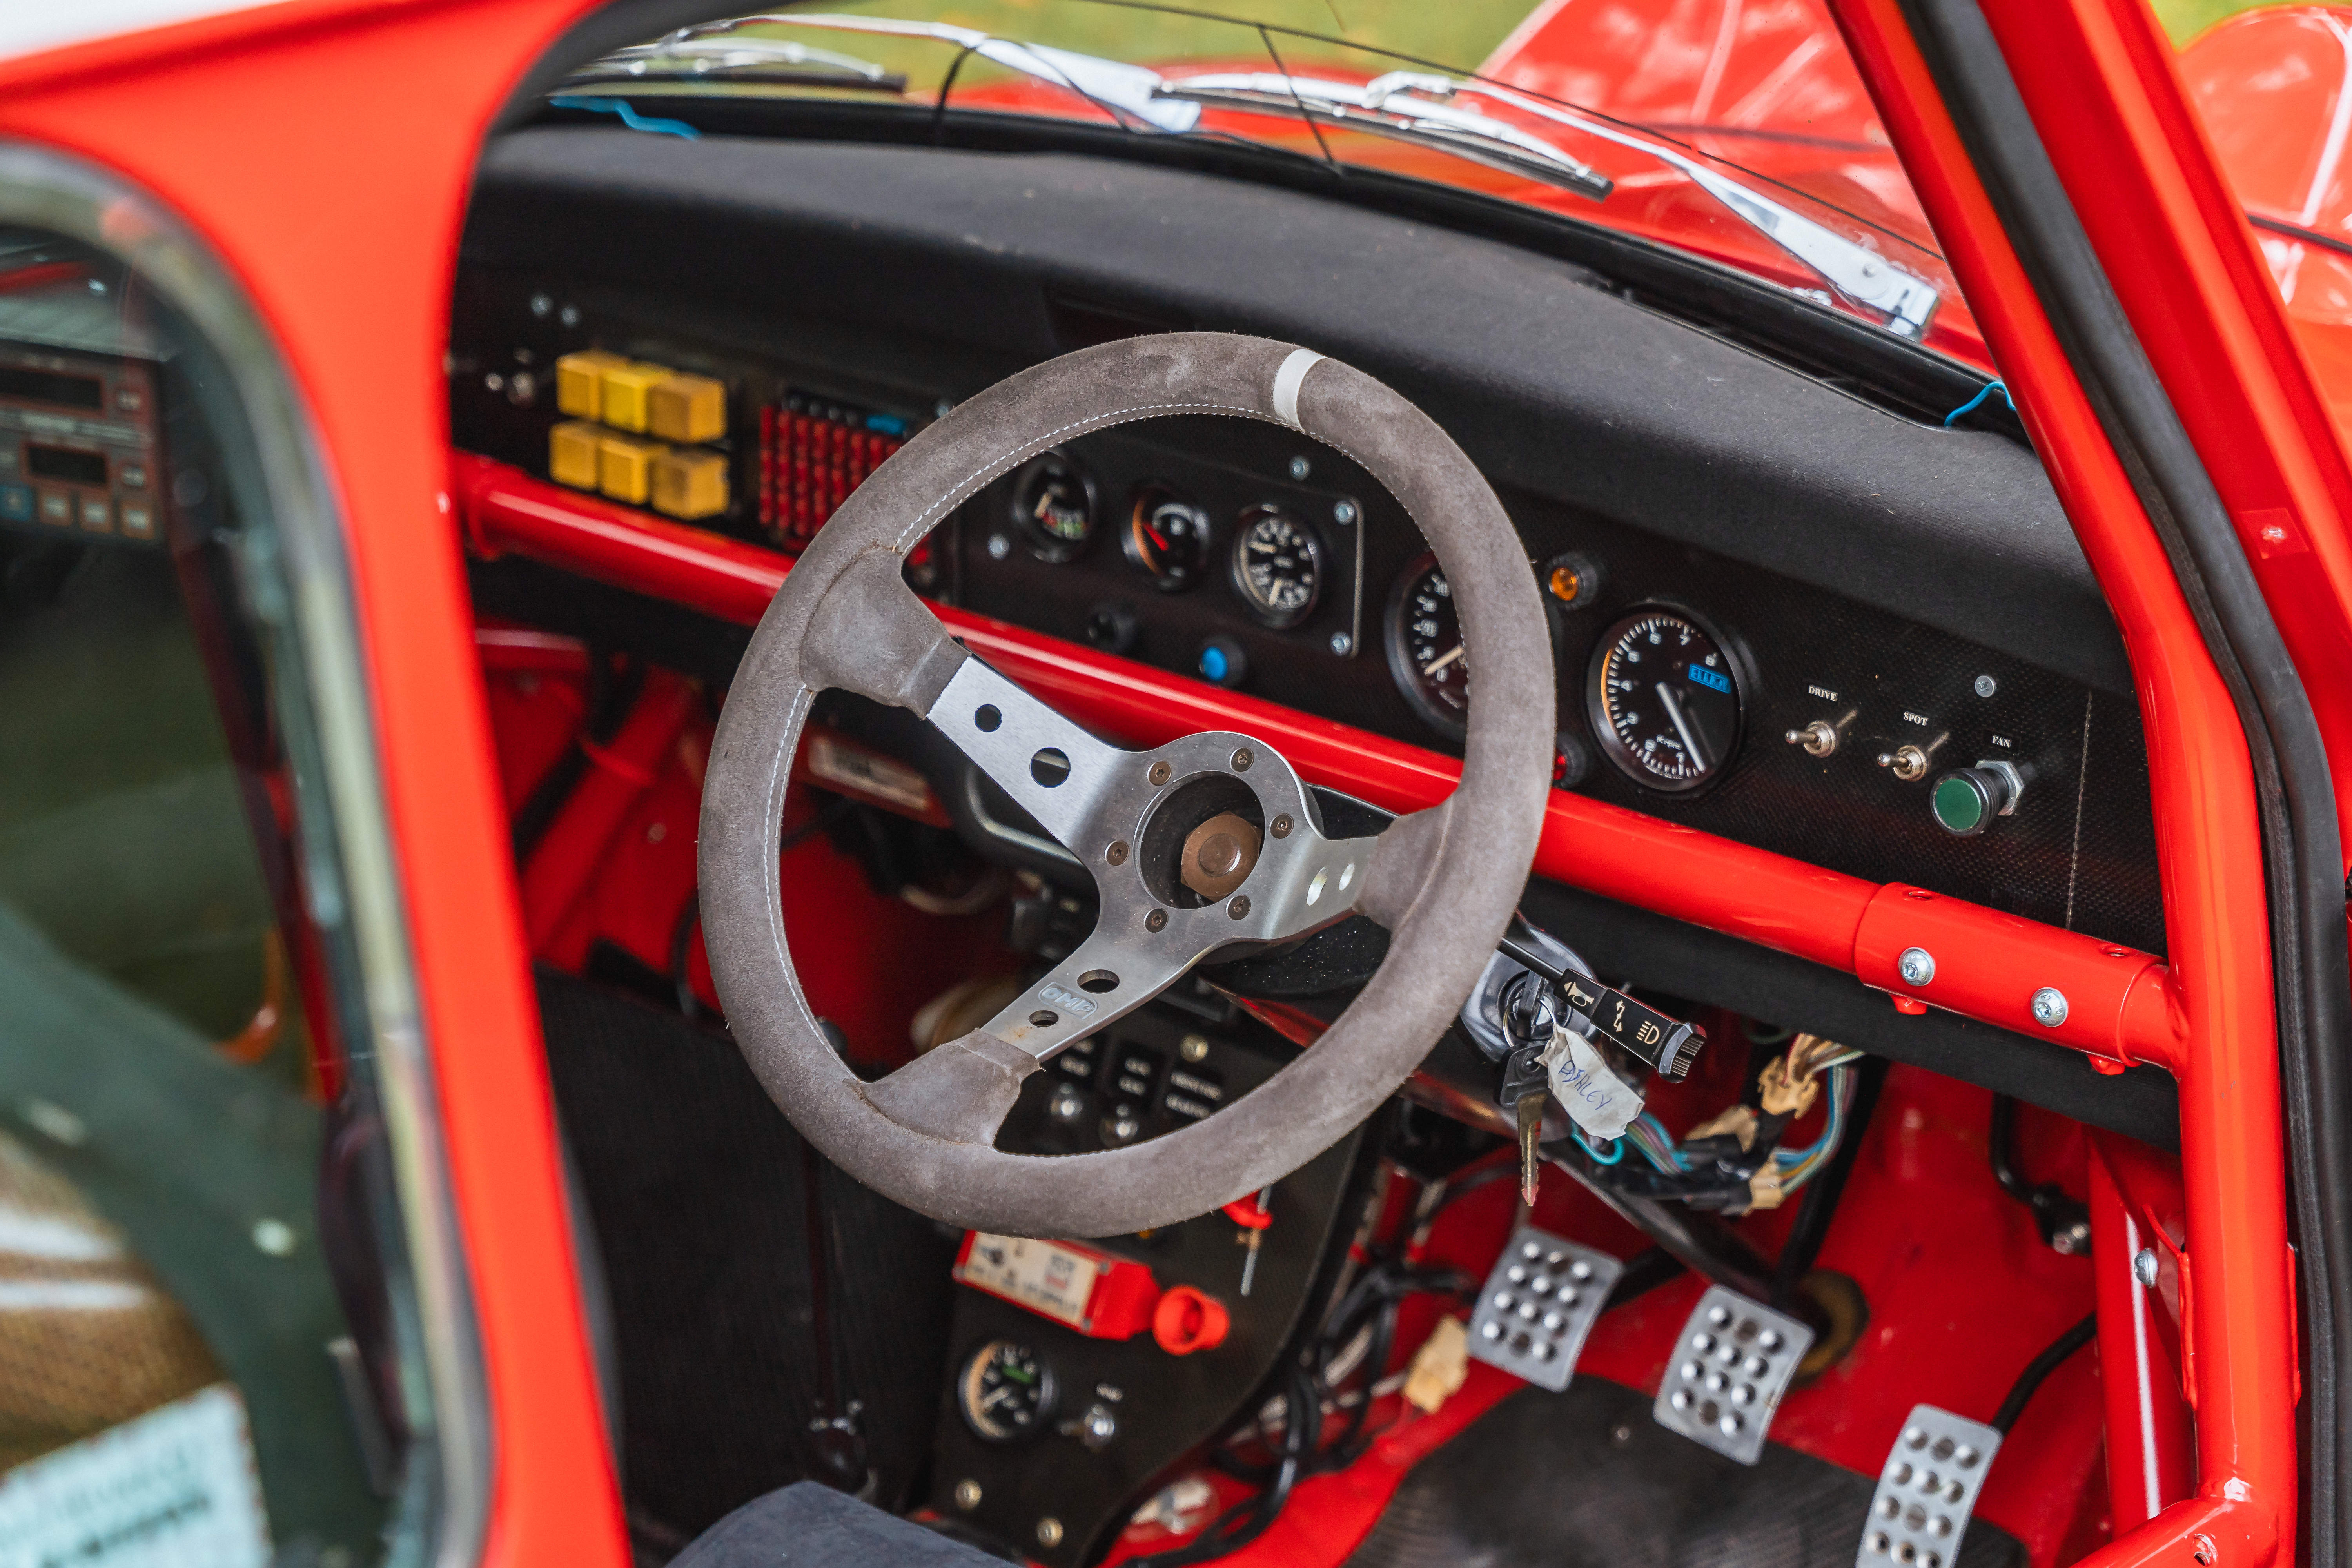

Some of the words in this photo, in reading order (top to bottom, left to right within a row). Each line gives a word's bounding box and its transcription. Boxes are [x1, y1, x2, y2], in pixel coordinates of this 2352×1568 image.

[1680, 634, 1690, 645] 7
[1621, 679, 1633, 692] 4
[1809, 685, 1838, 702] DRIVE
[1626, 712, 1639, 725] 3
[1903, 711, 1929, 726] SPOT
[1645, 739, 1657, 752] 2
[1992, 735, 2012, 748] FAN
[1676, 752, 1685, 763] 1
[1042, 987, 1094, 1012] OMP
